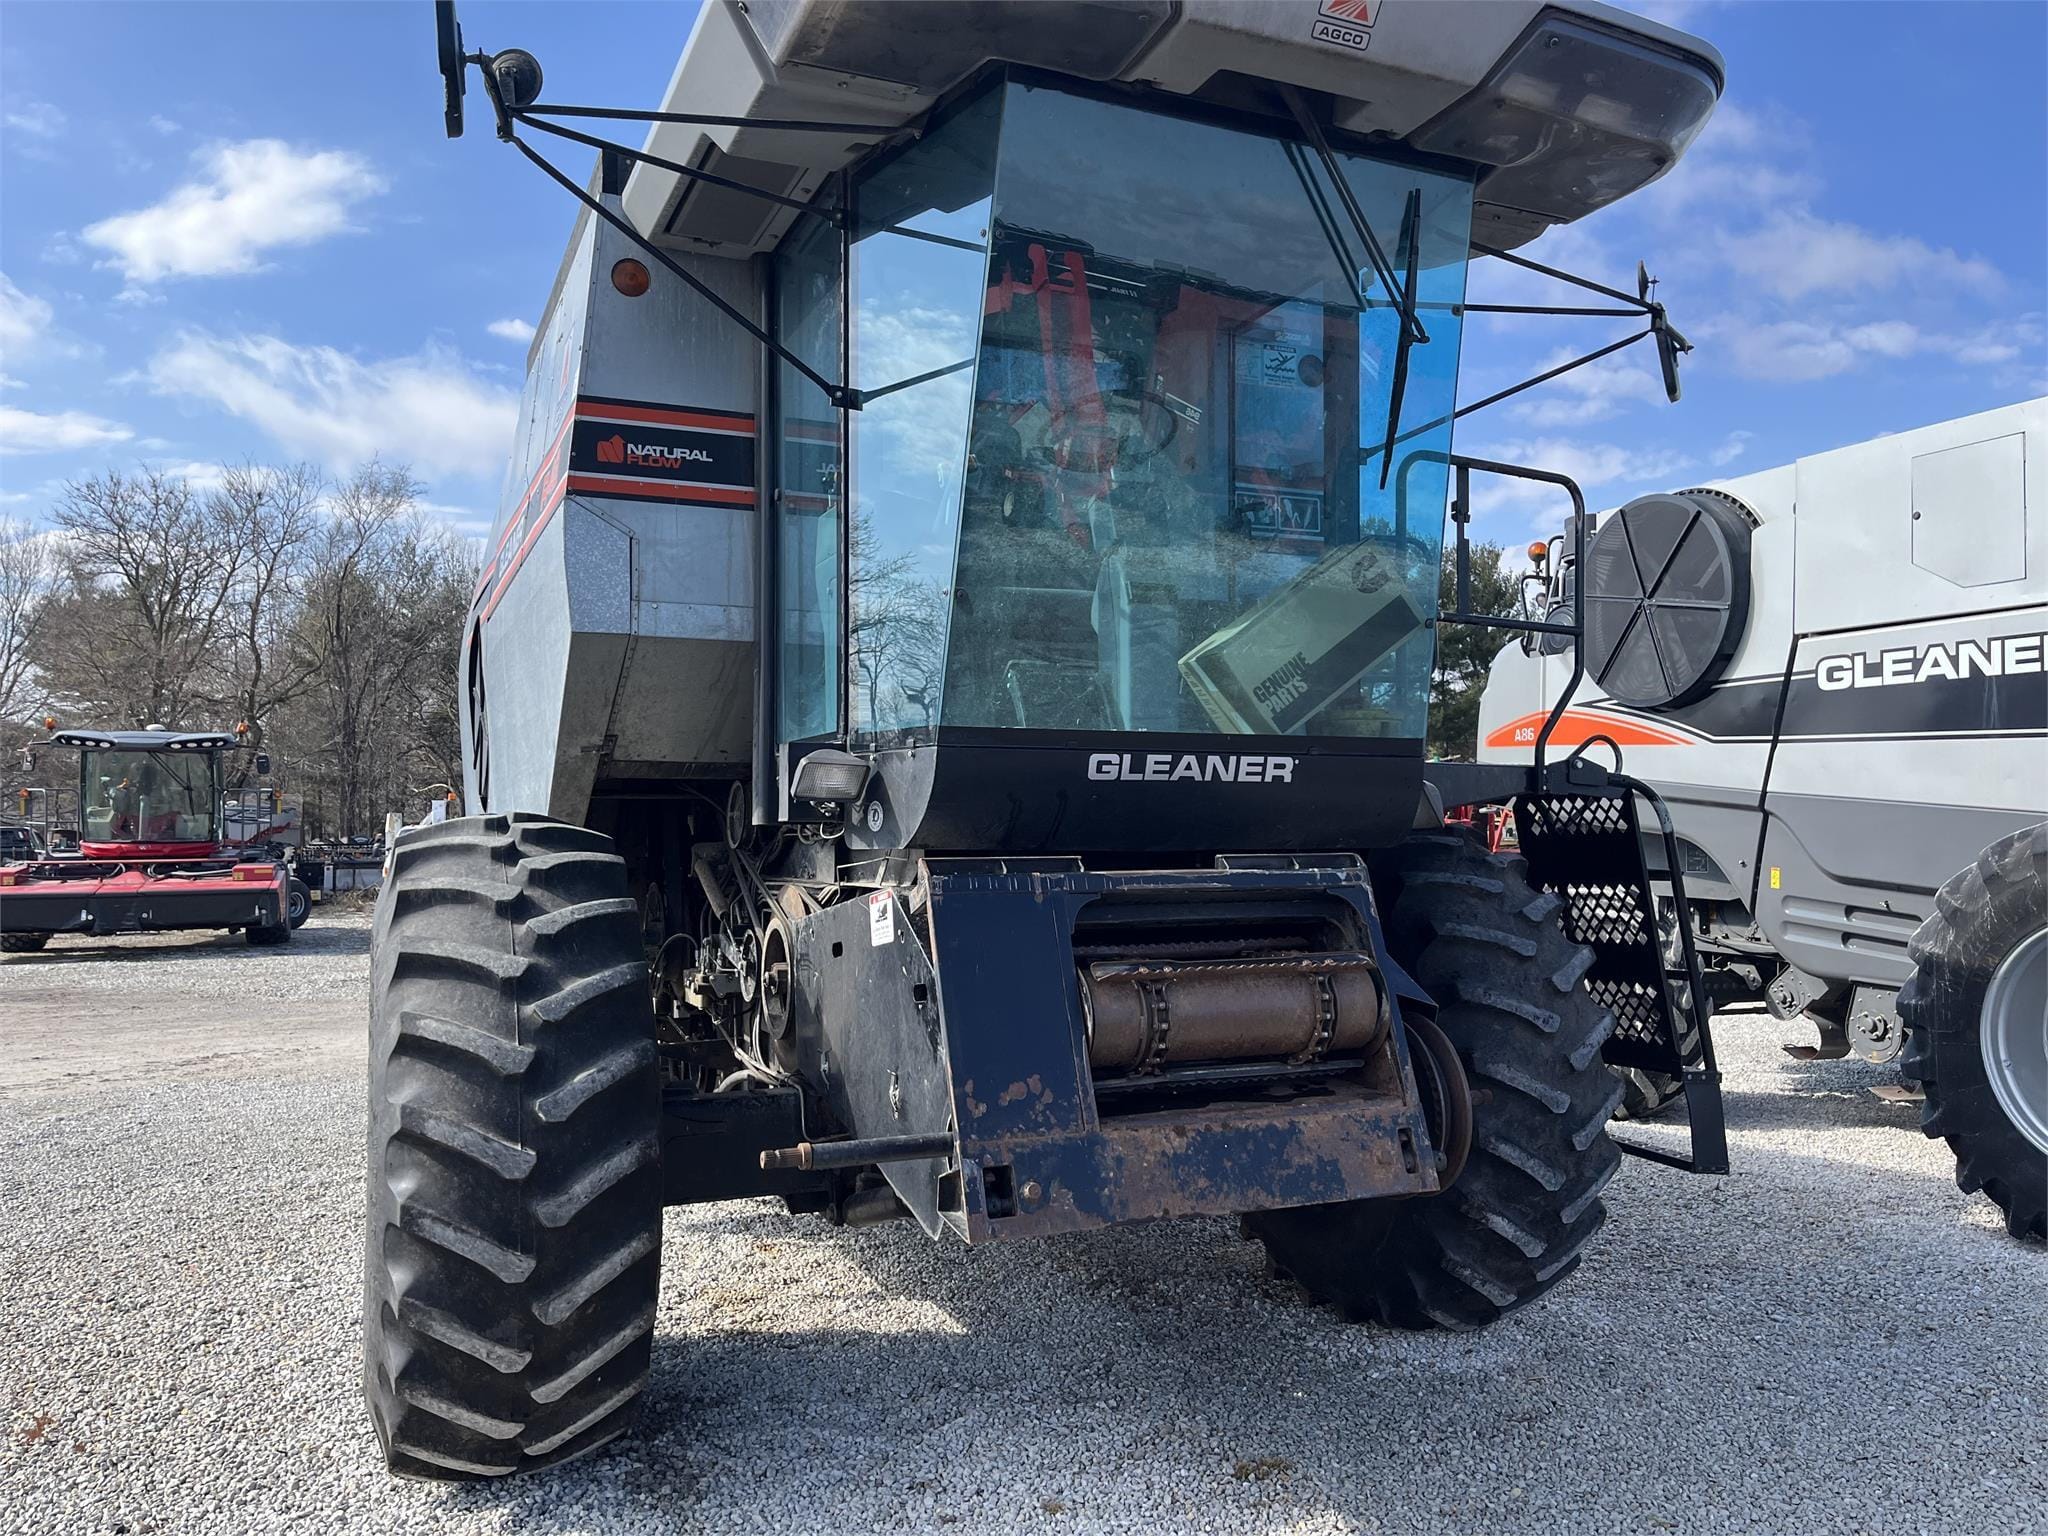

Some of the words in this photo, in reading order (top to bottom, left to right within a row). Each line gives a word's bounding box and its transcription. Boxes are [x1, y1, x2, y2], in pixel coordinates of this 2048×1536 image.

[1318, 26, 1364, 45] AGCO
[627, 443, 713, 462] NATURAL
[627, 454, 682, 469] FLOW
[1816, 633, 2048, 692] GLEANE
[1253, 651, 1309, 703] GENUINE
[1263, 676, 1309, 717] PARTS
[1514, 727, 1535, 742] A86
[1087, 753, 1296, 783] GLEANER
